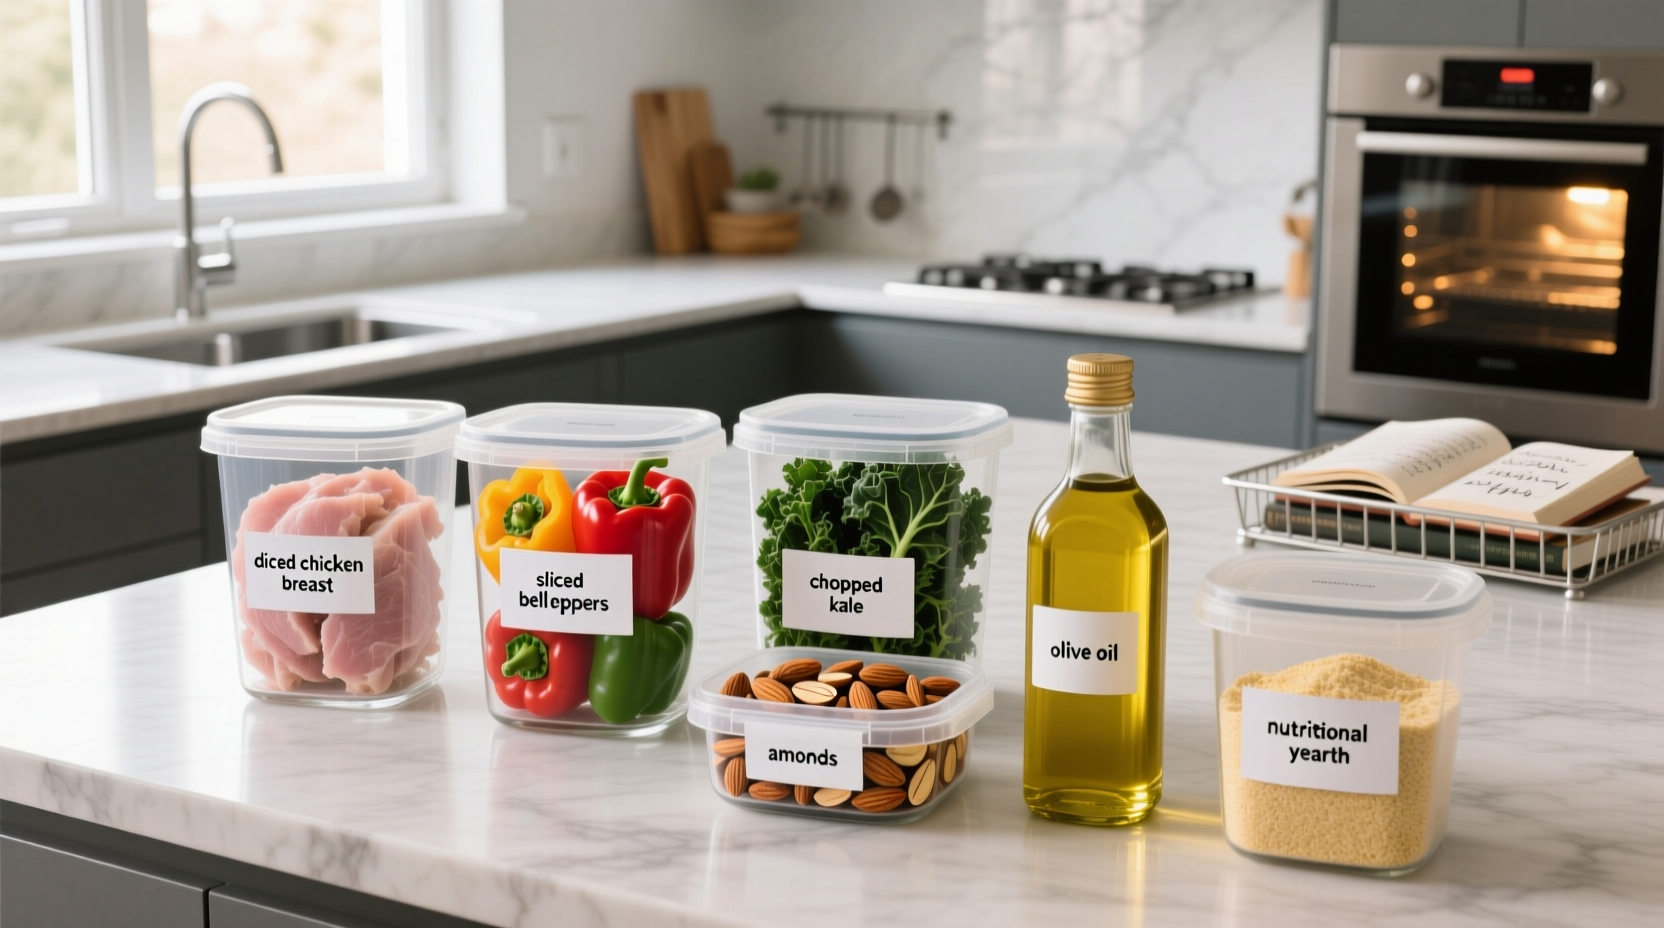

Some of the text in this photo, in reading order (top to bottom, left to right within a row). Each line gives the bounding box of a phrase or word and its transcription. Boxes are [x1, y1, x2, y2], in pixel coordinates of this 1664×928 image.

[254, 551, 364, 573] diced chicken
[282, 574, 334, 594] breast
[536, 571, 584, 589] sliced
[809, 572, 883, 596] chopped
[829, 595, 864, 614] kale
[1050, 640, 1118, 662] olive oil
[1267, 720, 1368, 743] nutritional
[768, 748, 838, 767] amonds
[1289, 746, 1350, 765] yearth
